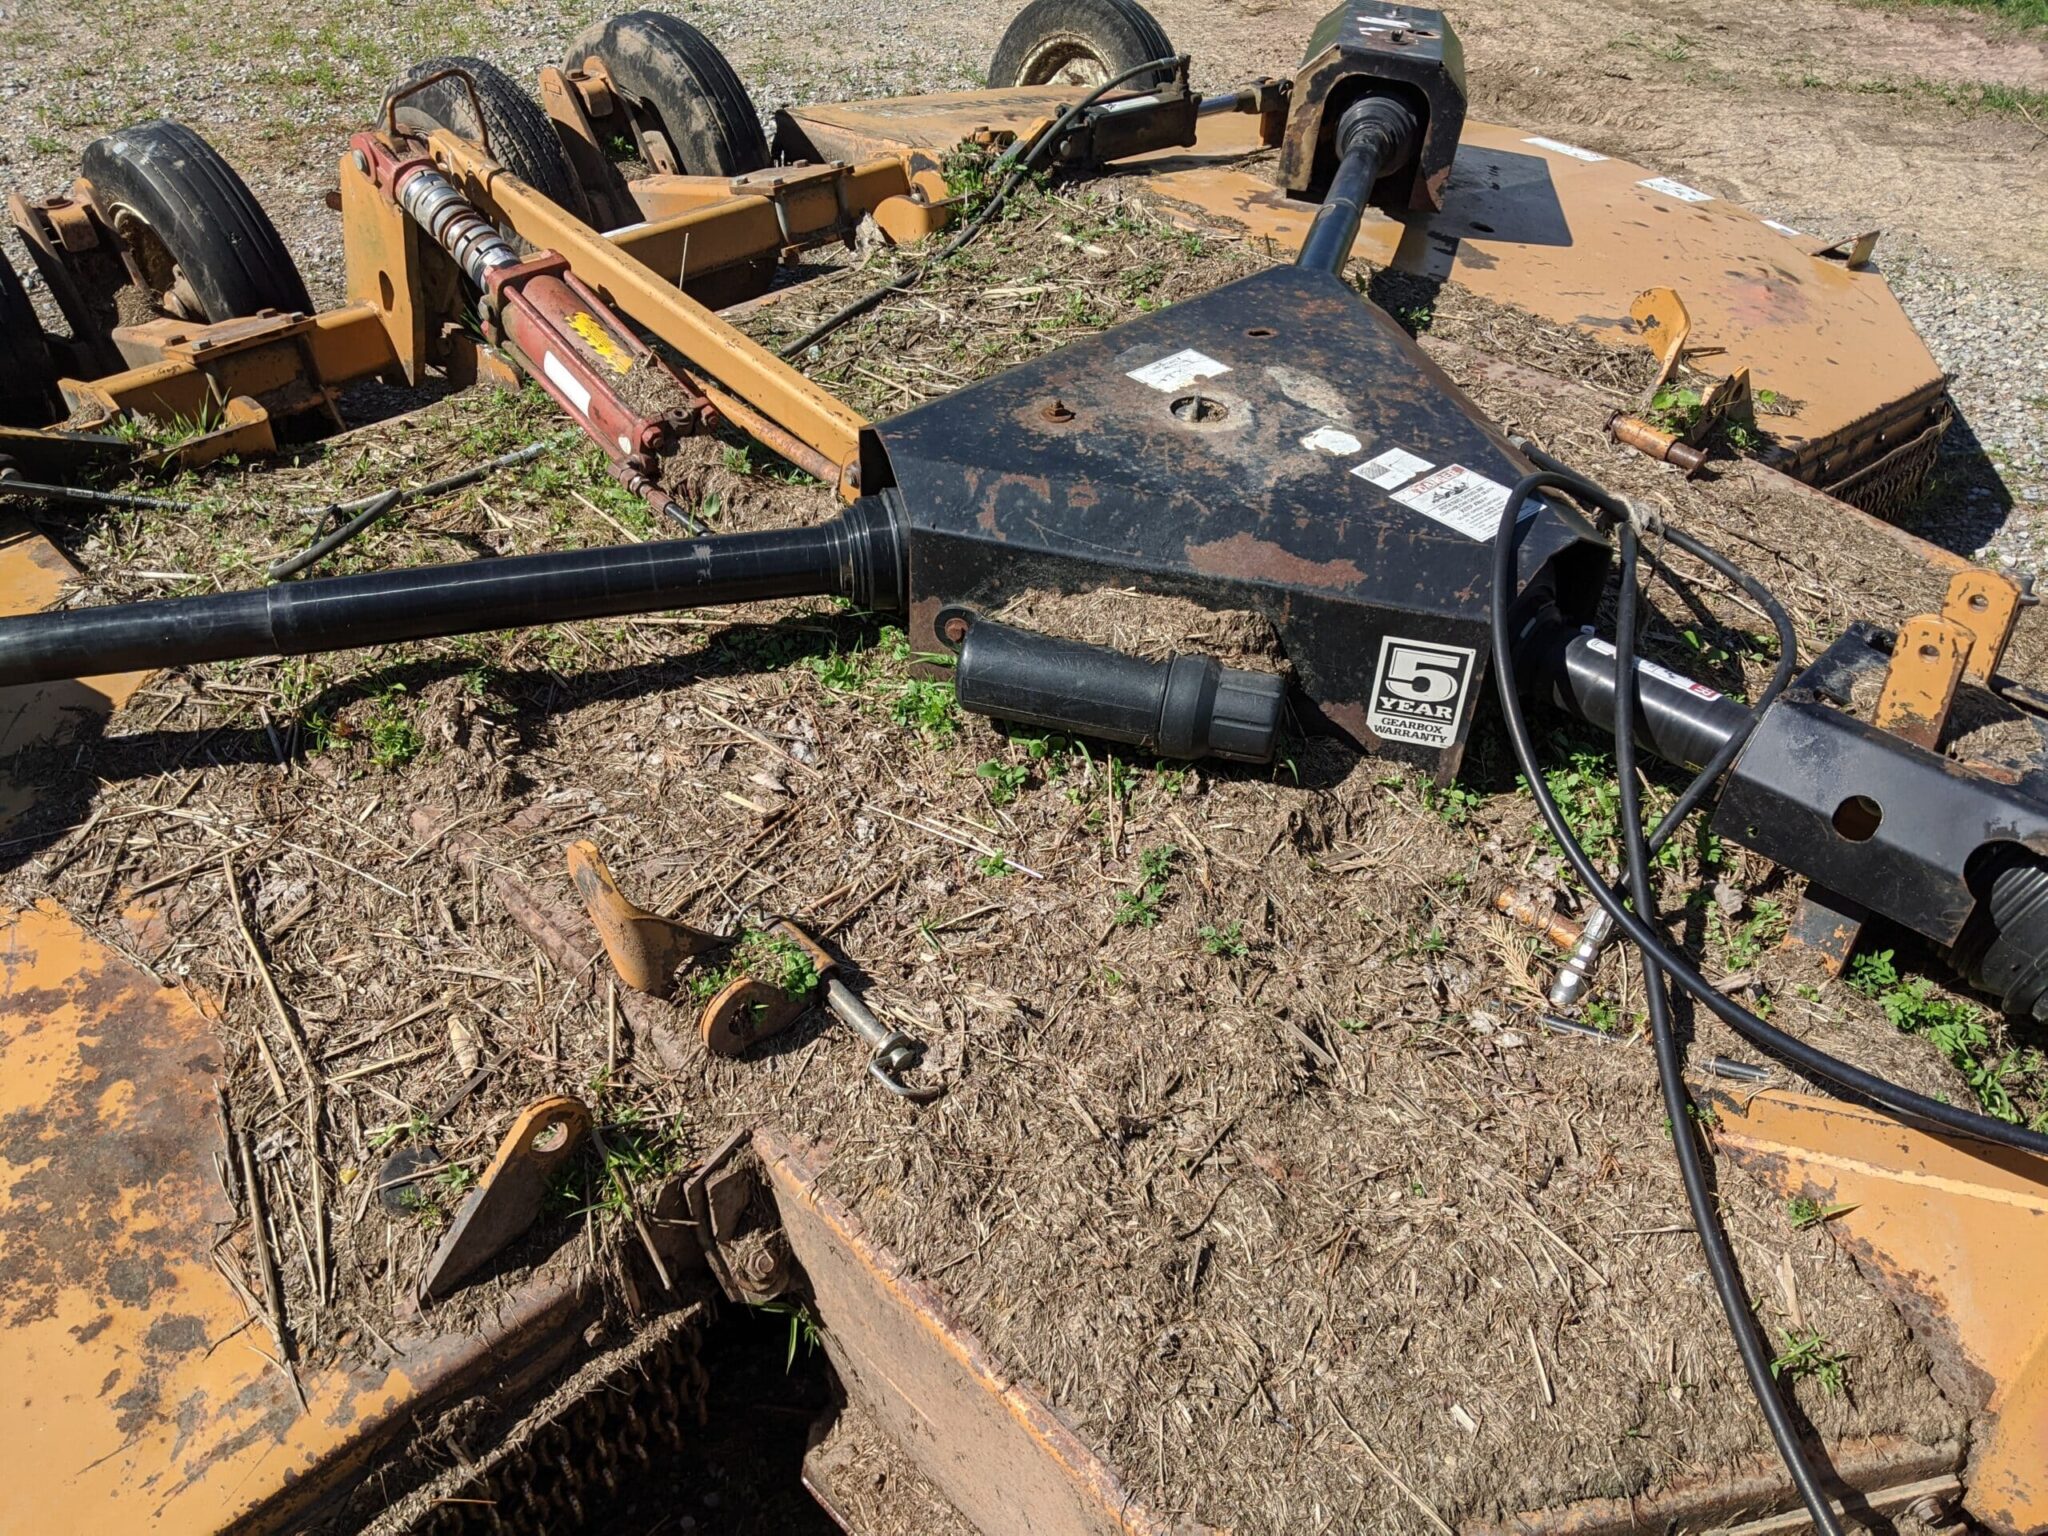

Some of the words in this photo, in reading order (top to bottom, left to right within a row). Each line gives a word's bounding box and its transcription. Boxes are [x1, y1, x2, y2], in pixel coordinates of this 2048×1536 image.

[1385, 647, 1460, 702] 5
[1379, 696, 1453, 720] YEAR
[1374, 724, 1448, 744] WARRANTY
[1381, 717, 1443, 734] GEARBOX
